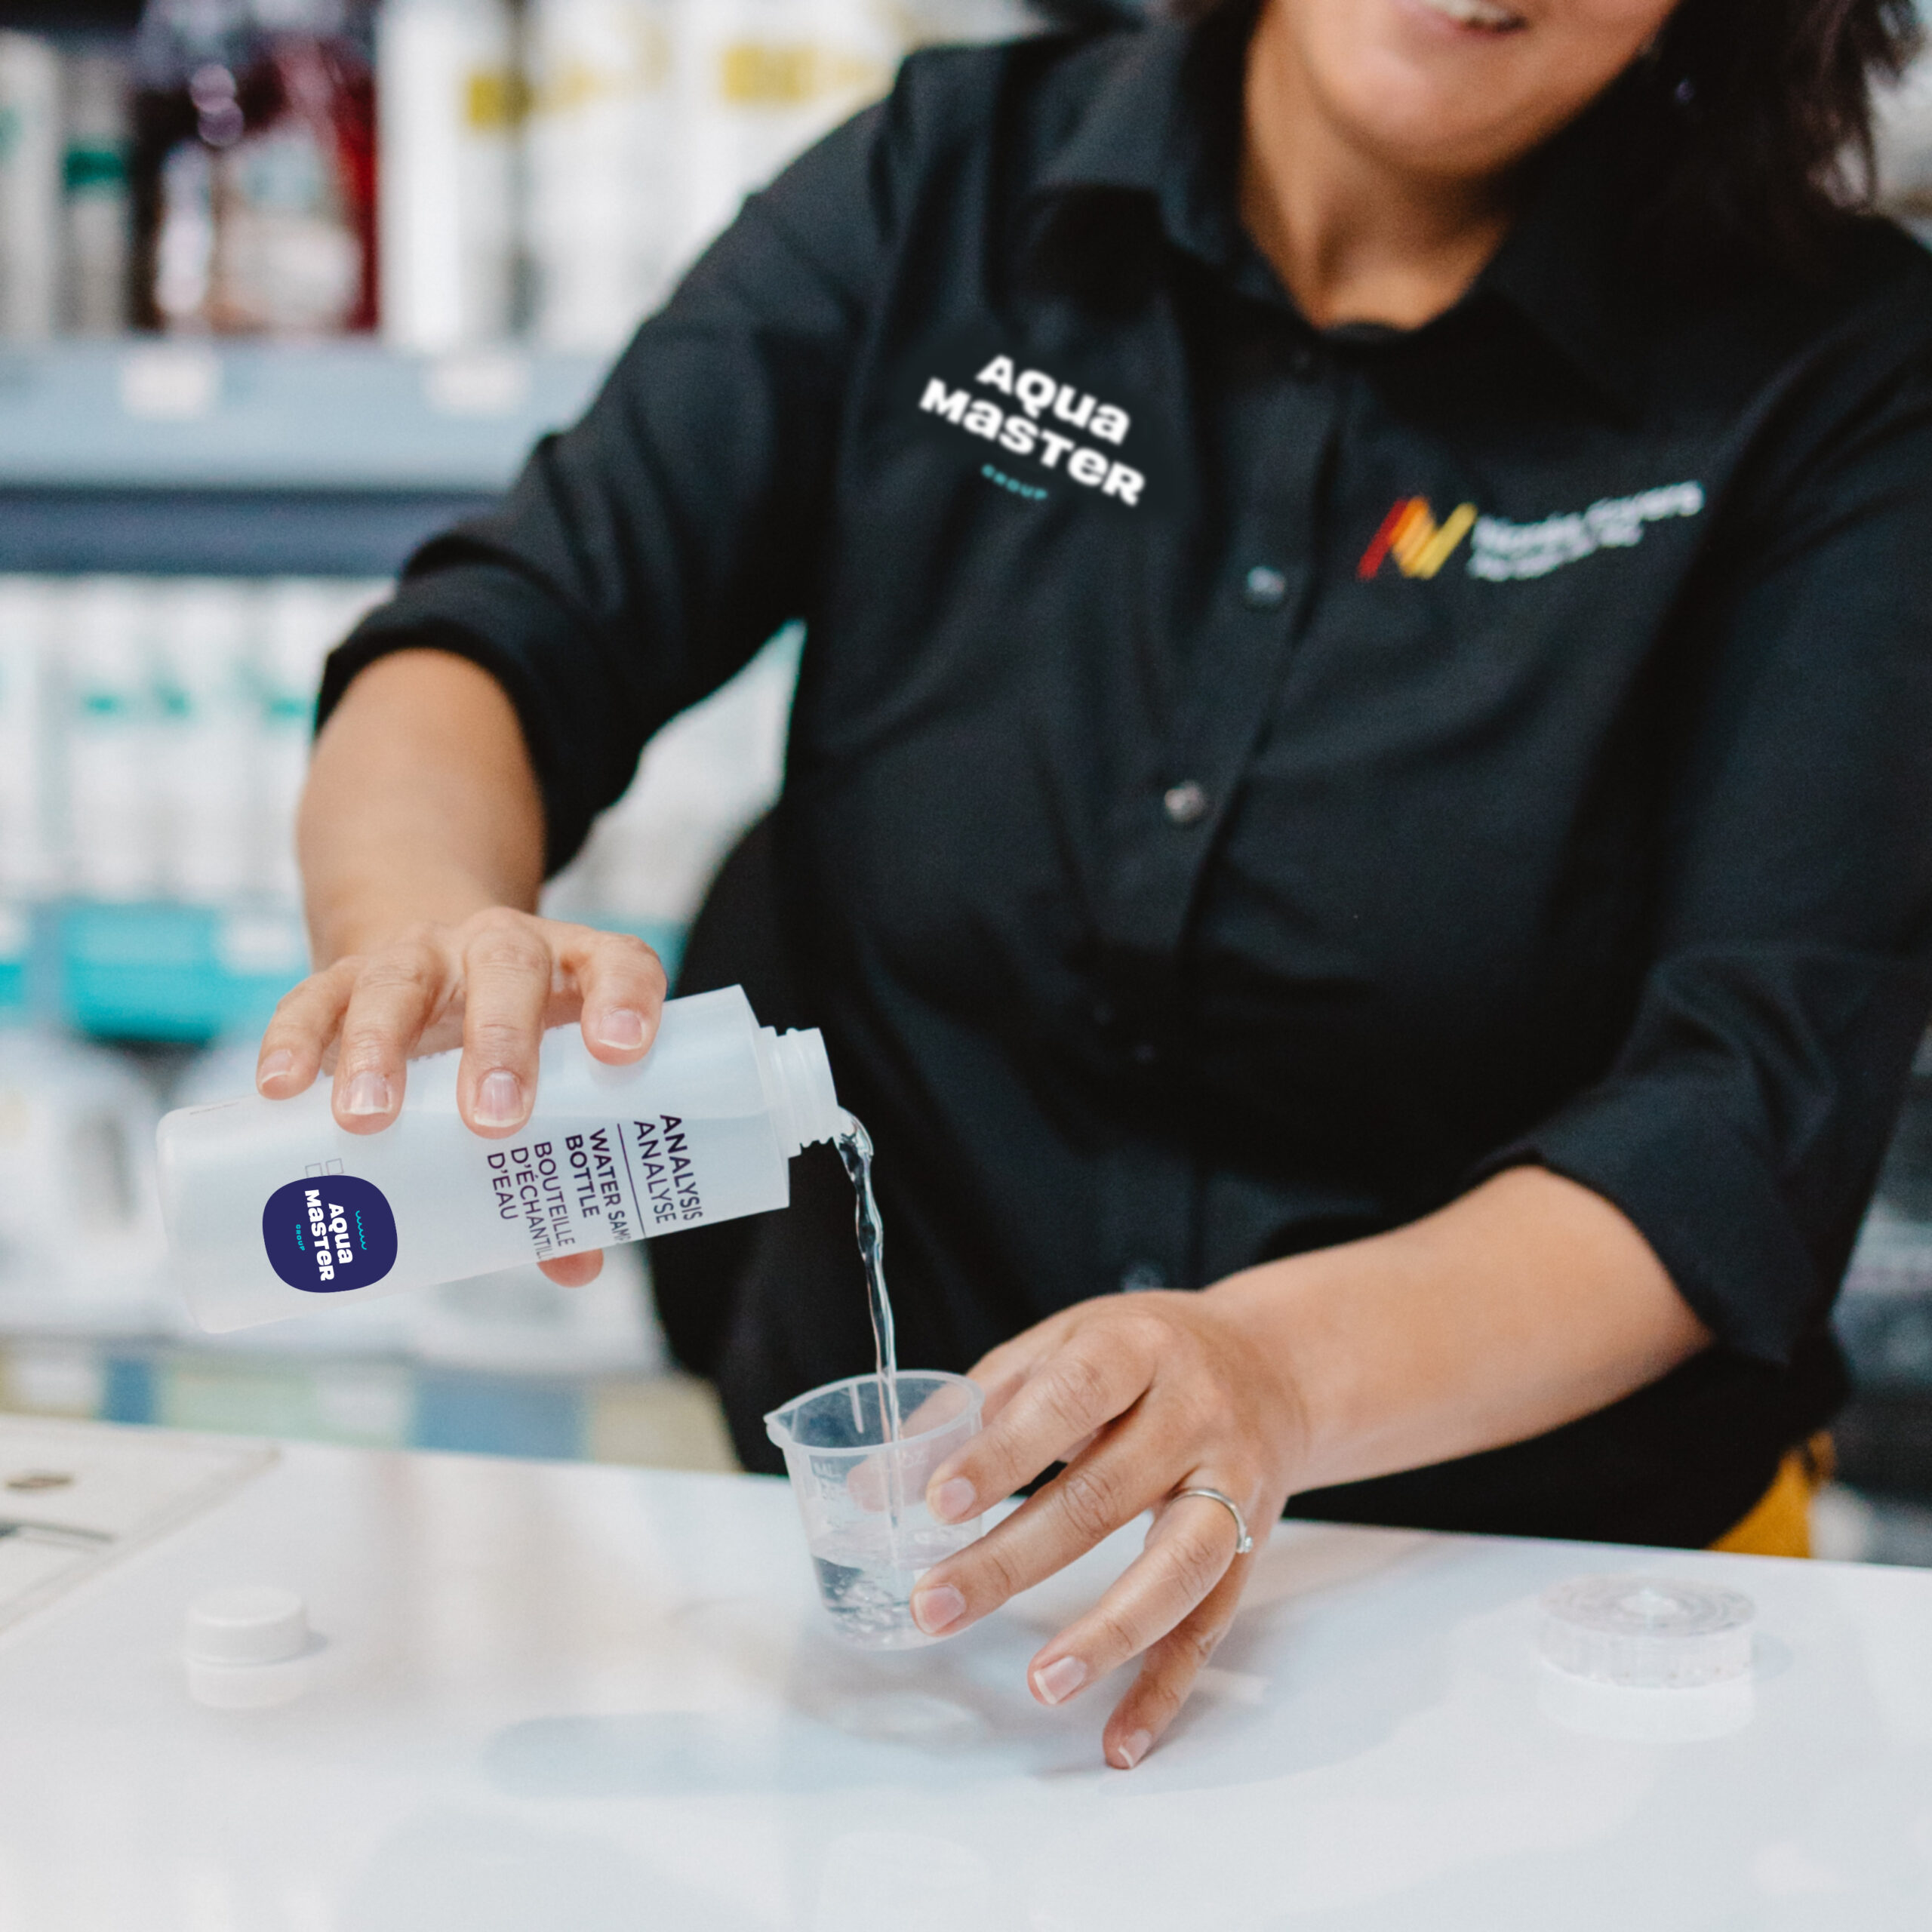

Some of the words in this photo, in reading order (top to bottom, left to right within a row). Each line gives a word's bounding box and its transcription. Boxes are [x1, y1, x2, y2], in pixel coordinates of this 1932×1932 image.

[487, 1152, 518, 1220] D'EAU
[534, 1142, 575, 1247] BOUTEILLE
[565, 1134, 600, 1218] BOTTLE
[589, 1128, 621, 1208] WATER
[633, 1121, 676, 1224] ANALYSE
[660, 1114, 703, 1221] ANALYSIS
[295, 1224, 305, 1251] GROUP
